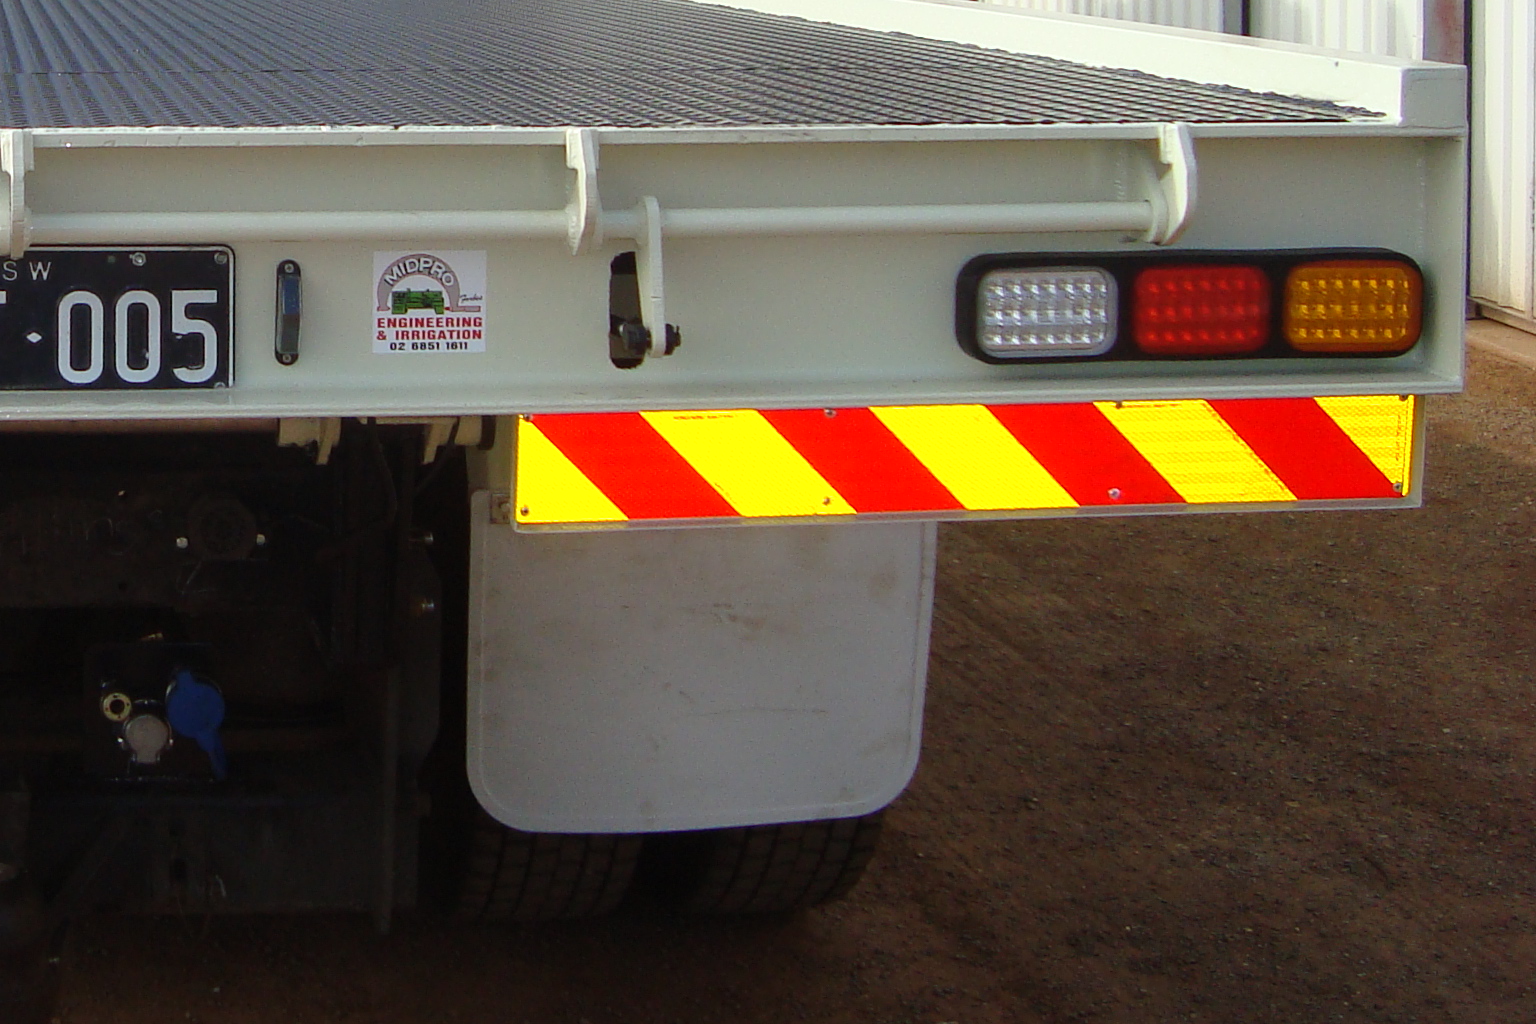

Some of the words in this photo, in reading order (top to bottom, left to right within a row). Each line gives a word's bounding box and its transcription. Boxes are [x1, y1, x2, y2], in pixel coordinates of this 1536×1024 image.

[384, 257, 455, 286] MIDPRO
[377, 316, 483, 328] ENGINEERING
[376, 330, 387, 341] &
[395, 329, 482, 341] IRRIGATION
[389, 342, 406, 351] 02
[411, 342, 440, 351] 6851
[446, 342, 468, 350] 1611
